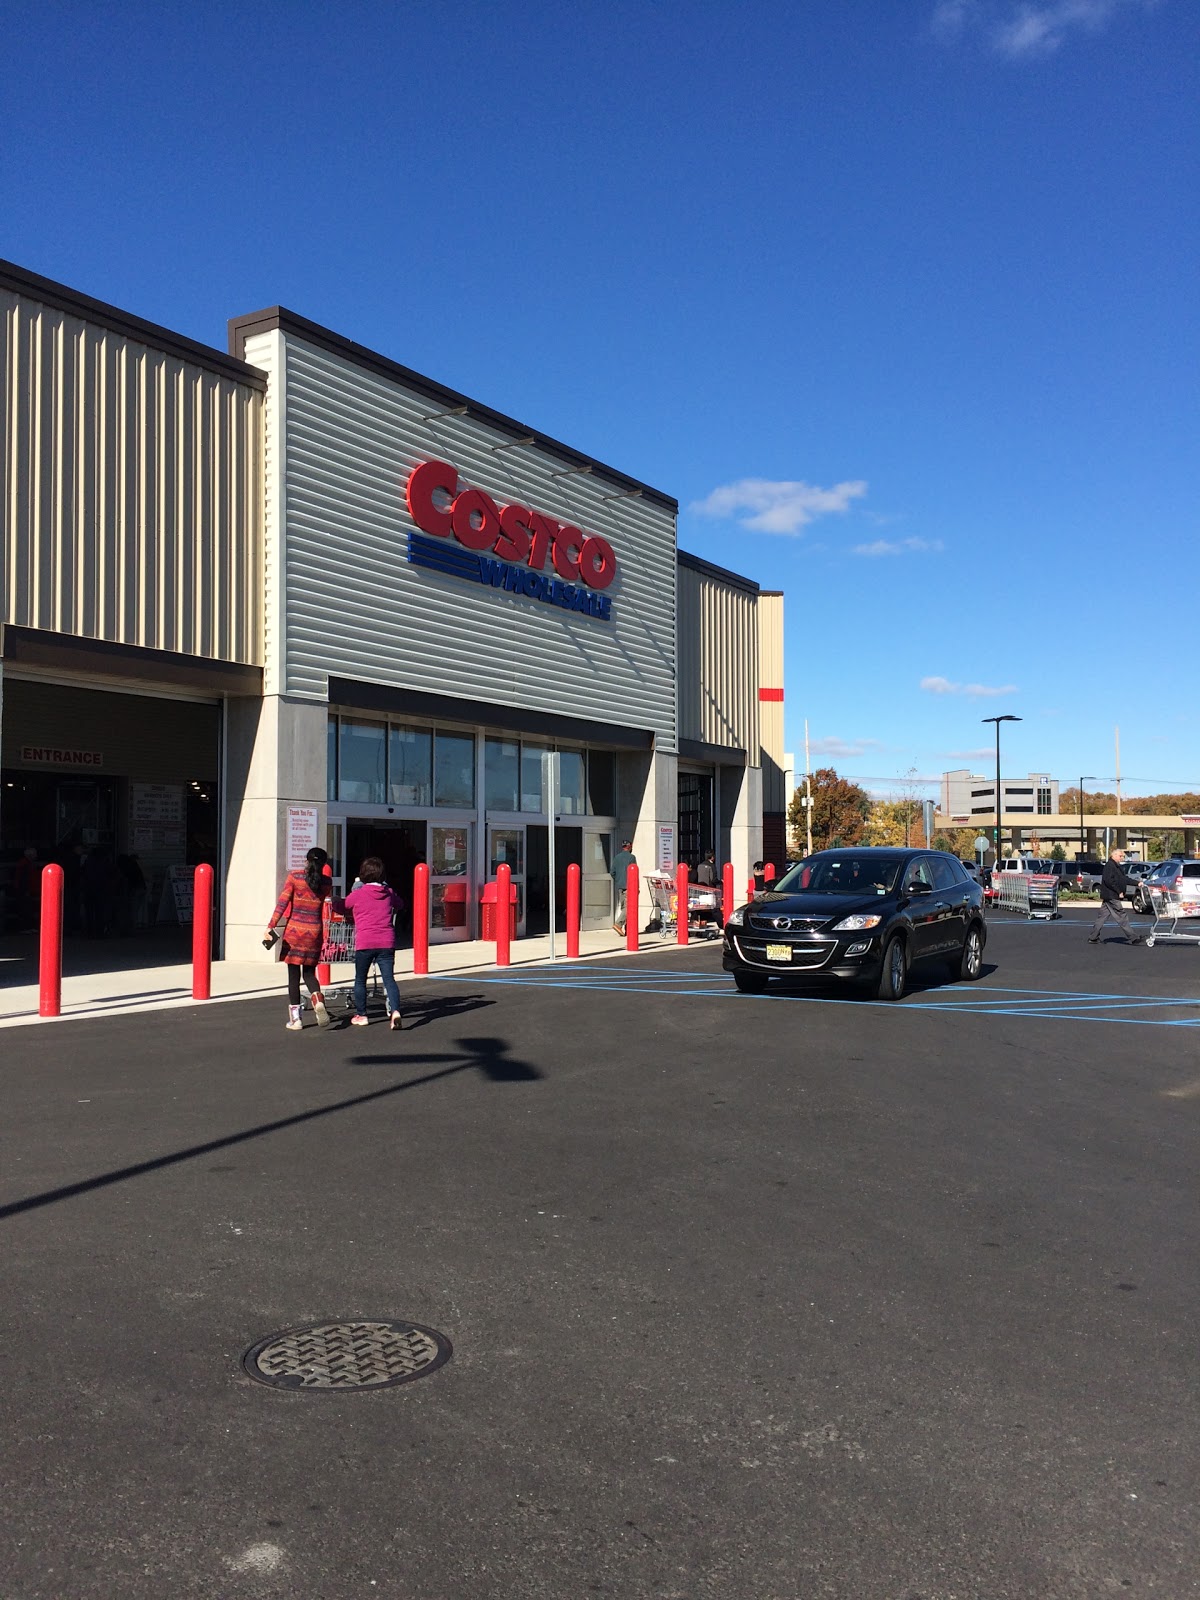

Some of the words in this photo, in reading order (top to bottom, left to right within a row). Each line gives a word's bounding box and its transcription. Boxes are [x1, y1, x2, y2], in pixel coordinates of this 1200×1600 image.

[406, 460, 617, 590] COSTCO
[478, 556, 612, 621] WHOLESALE
[23, 747, 102, 765] ENTRANCE
